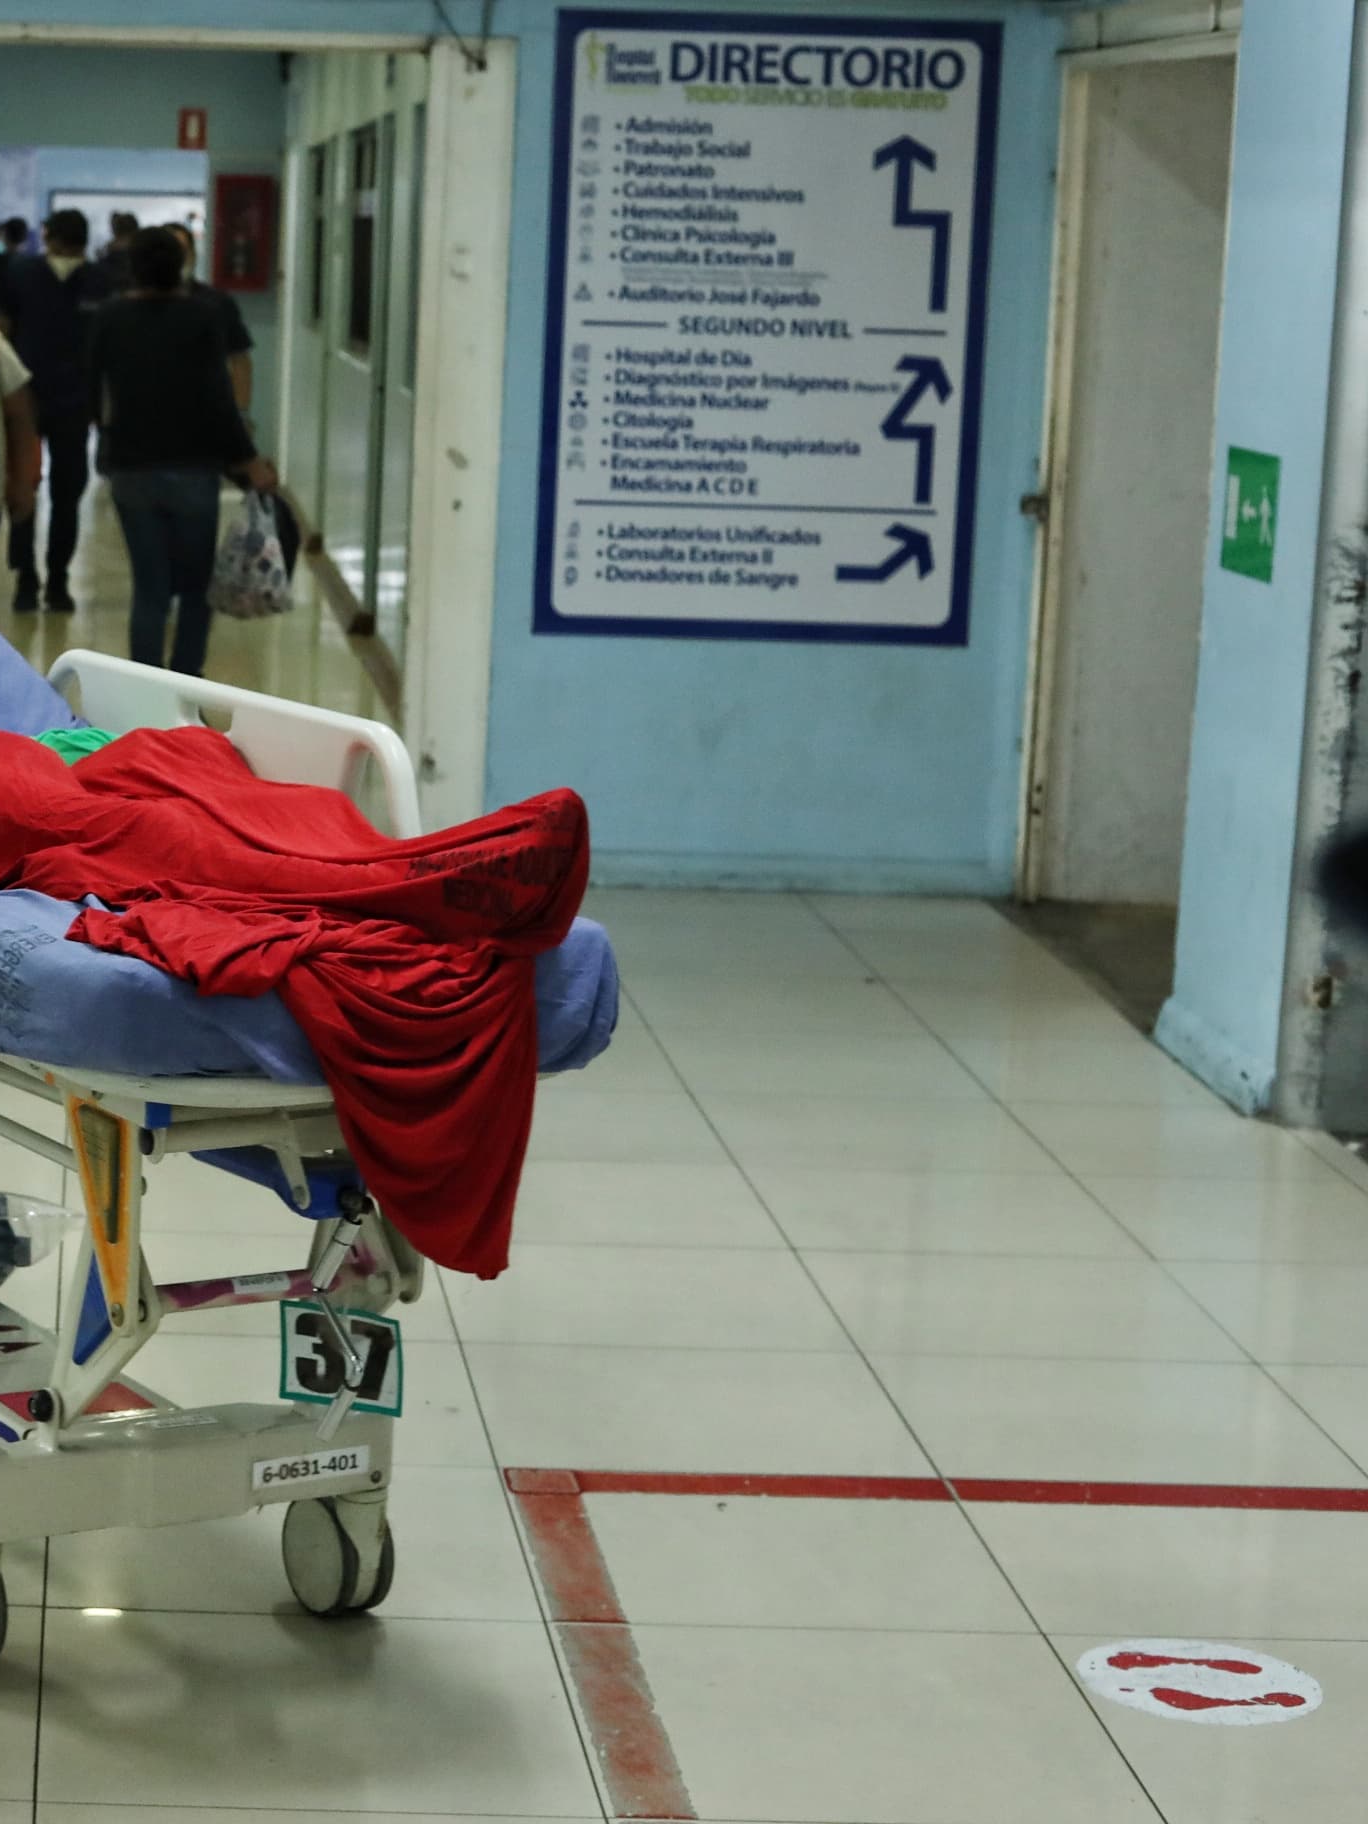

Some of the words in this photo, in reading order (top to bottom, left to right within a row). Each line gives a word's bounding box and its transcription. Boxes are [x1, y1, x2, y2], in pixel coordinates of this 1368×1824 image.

[669, 40, 965, 89] DIRECTORIO
[626, 116, 713, 134] Admisión
[625, 138, 693, 160] Trabajo
[696, 140, 751, 158] Social
[623, 160, 715, 178] Patronato
[678, 315, 786, 336] SEGUNDO
[790, 319, 852, 340] NIVEL
[726, 375, 757, 391] por
[610, 475, 693, 493] Medicina
[696, 479, 710, 494] A
[713, 479, 727, 495] C
[729, 479, 744, 495] D
[747, 479, 759, 496] E
[607, 524, 721, 542] Laboratorios
[726, 526, 821, 546] Unificados
[605, 564, 704, 584] Donadores
[708, 568, 730, 584] de
[734, 569, 799, 590] Sangre
[295, 1312, 395, 1401] 37
[262, 1453, 359, 1484] 6-0631-401
